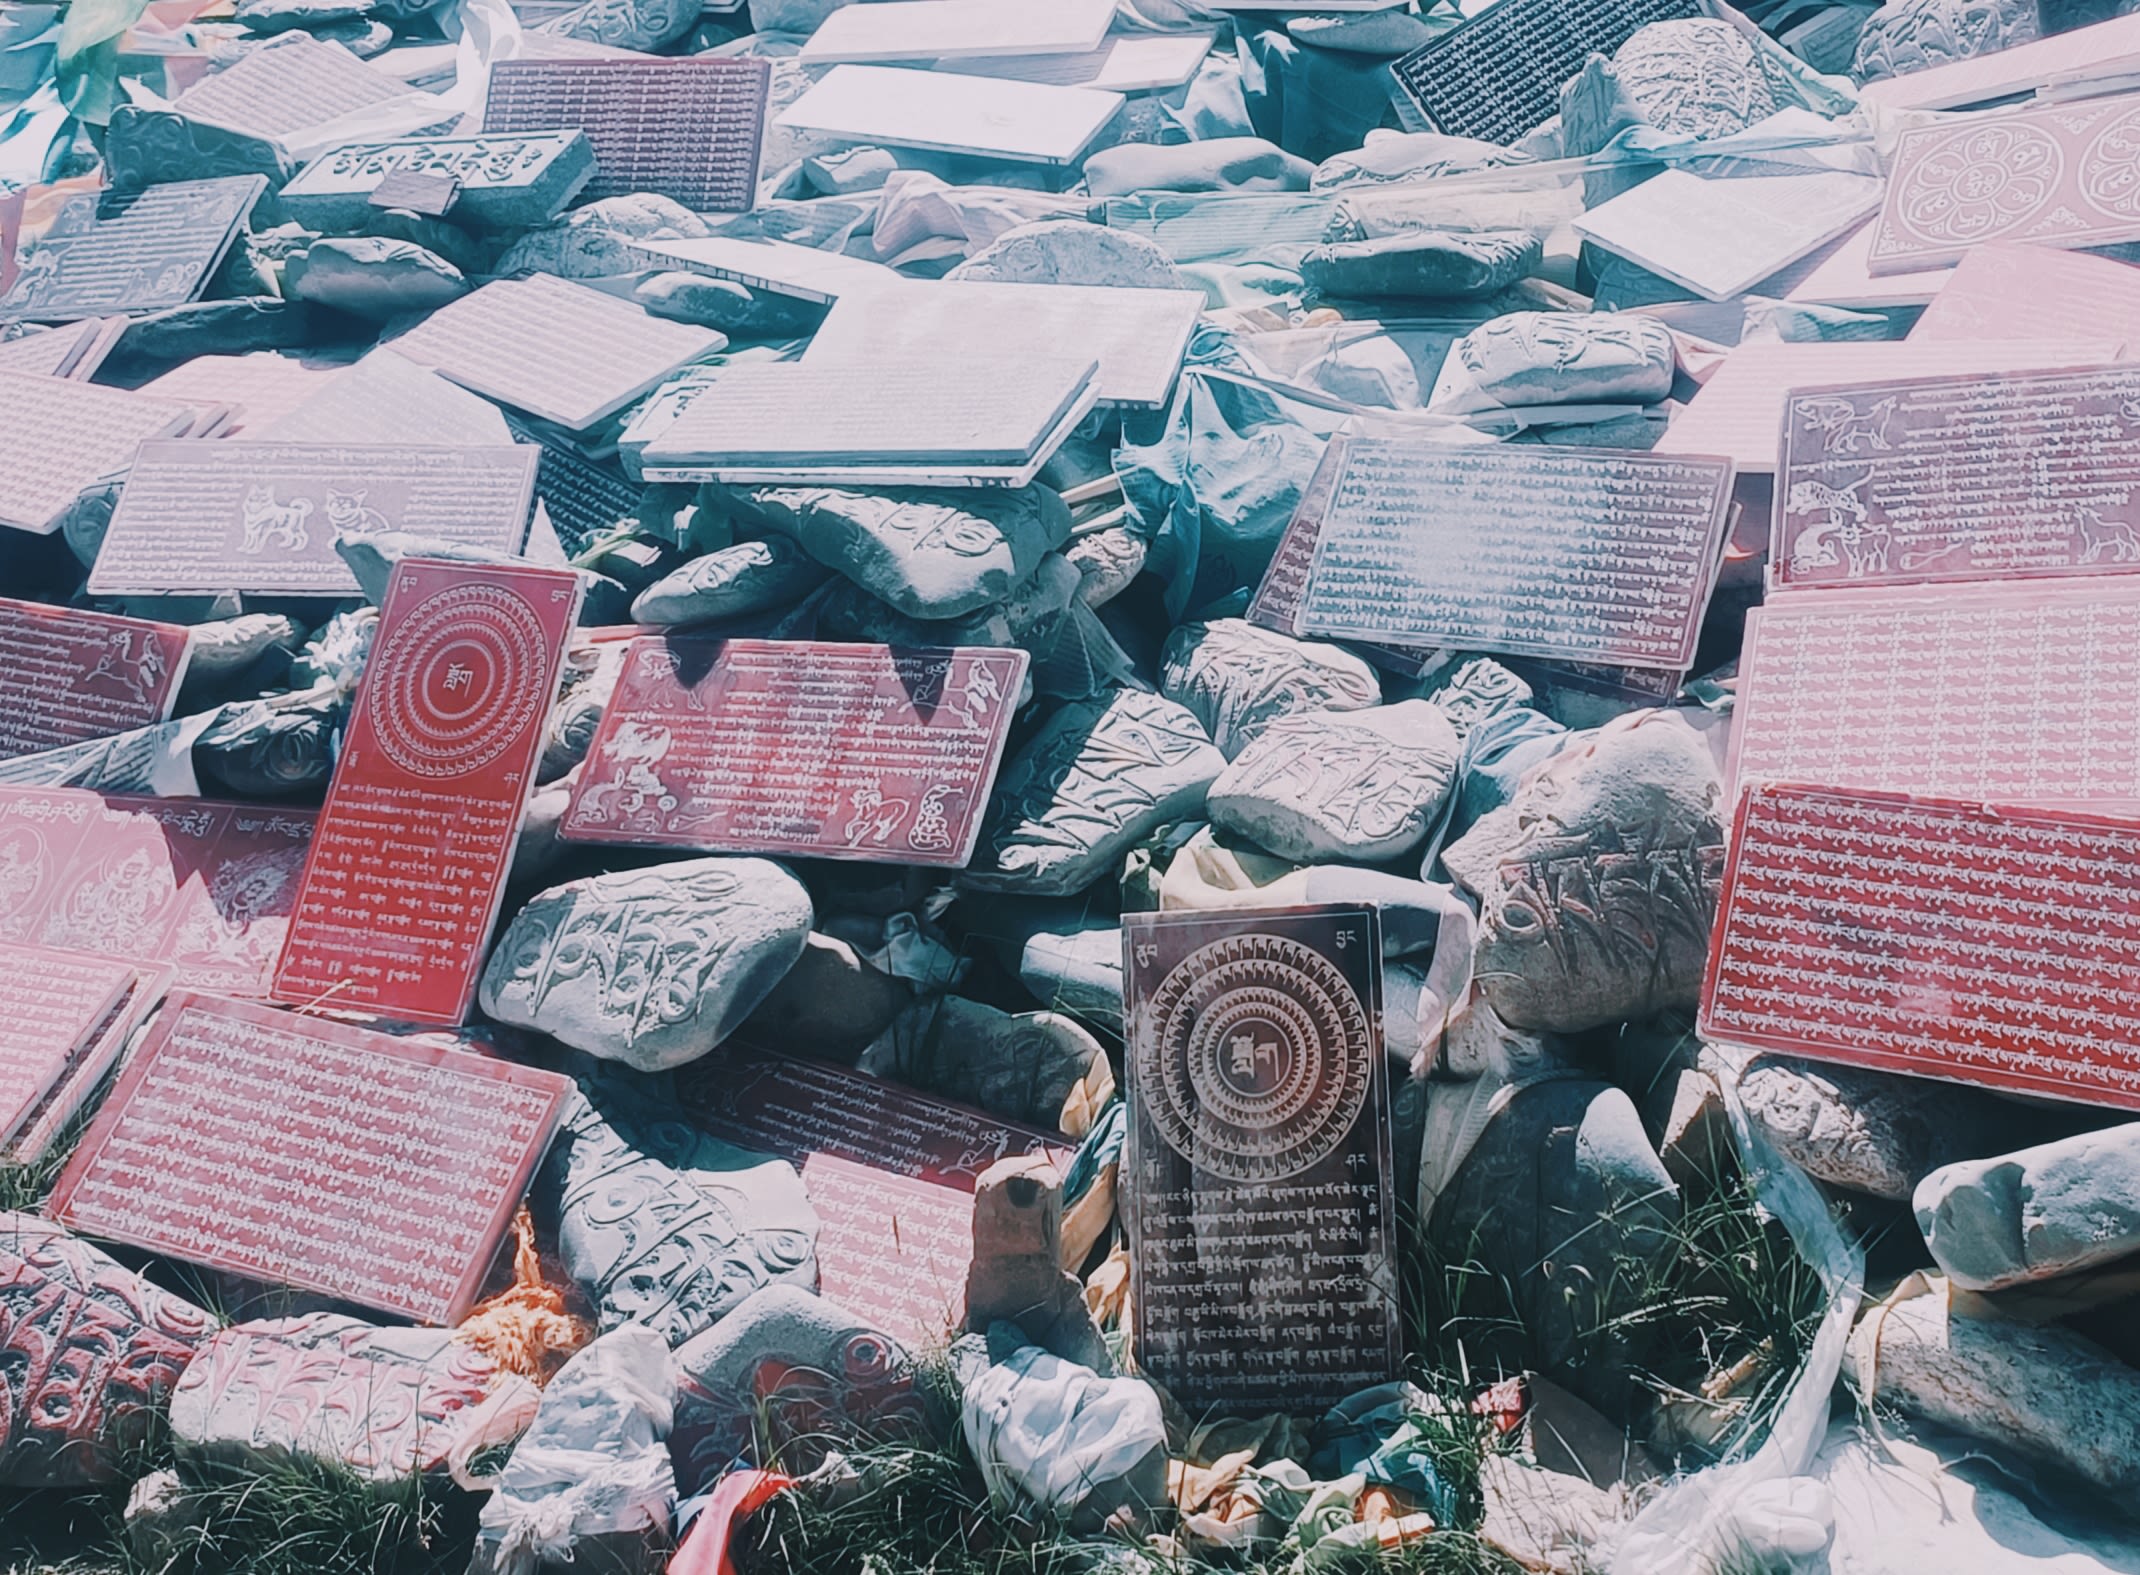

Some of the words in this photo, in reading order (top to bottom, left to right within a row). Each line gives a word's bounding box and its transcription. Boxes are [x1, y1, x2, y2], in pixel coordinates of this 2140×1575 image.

[1336, 929, 1358, 950] བྱང
[1136, 943, 1159, 969] ནུབ
[1344, 1153, 1369, 1176] ཤར
